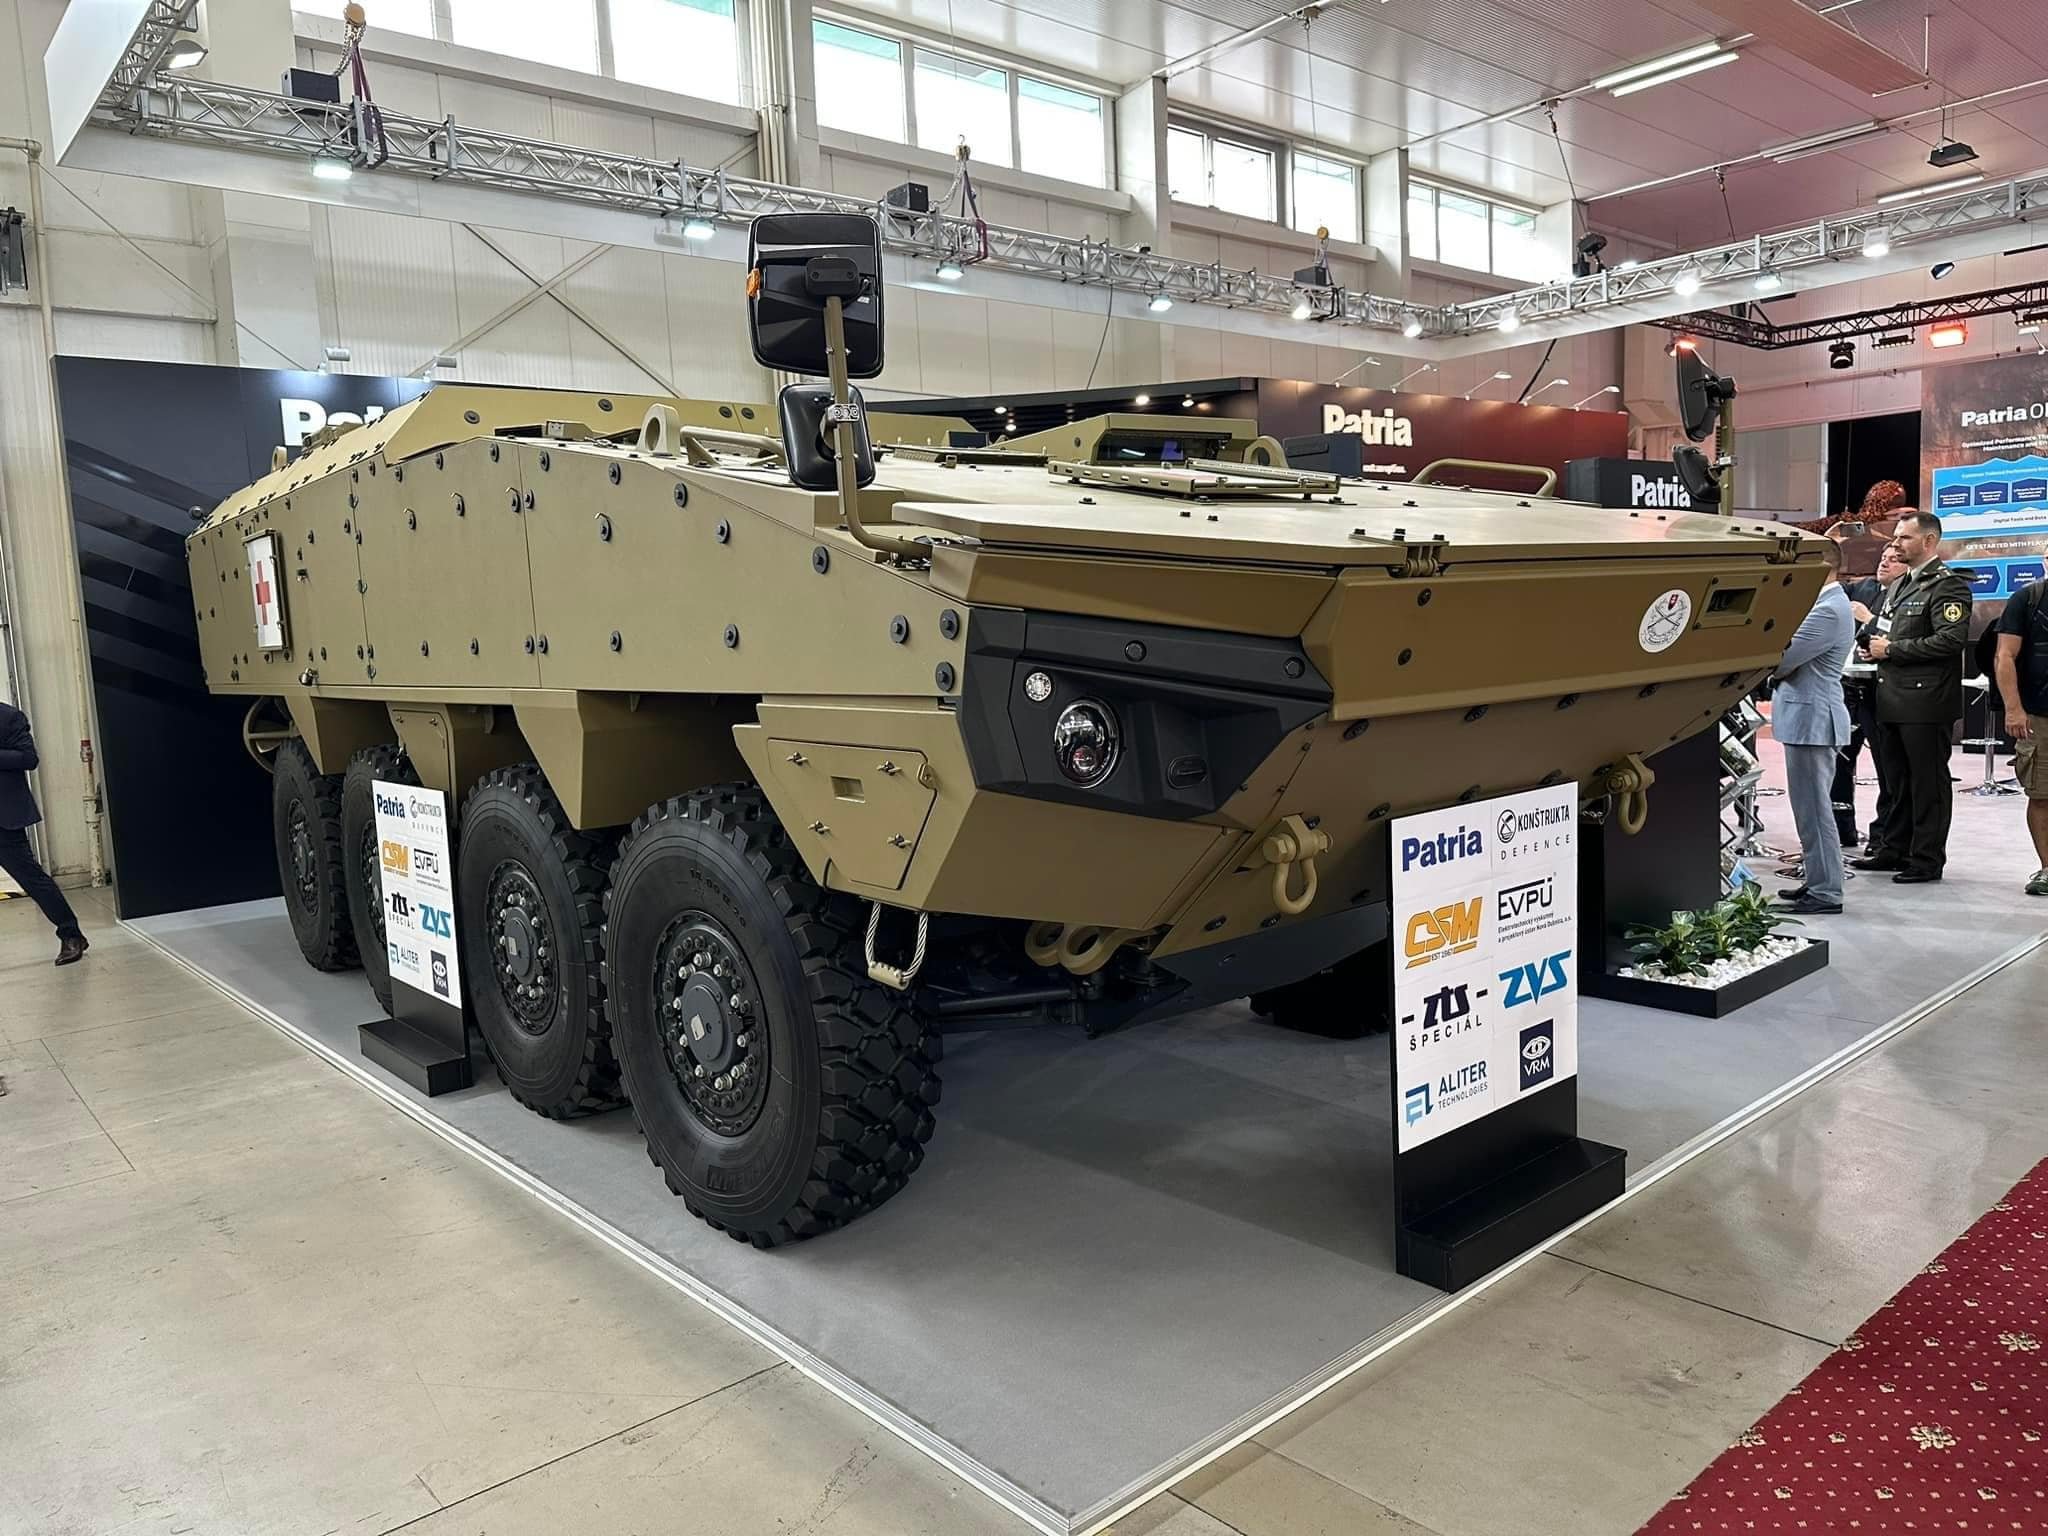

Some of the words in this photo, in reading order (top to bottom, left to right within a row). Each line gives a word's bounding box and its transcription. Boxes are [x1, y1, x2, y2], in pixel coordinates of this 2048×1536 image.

[1323, 404, 1413, 447] Patria
[1961, 406, 2028, 427] Patria
[1631, 474, 1691, 507] Patria
[376, 793, 405, 819] Patria
[1518, 804, 1570, 832] KONŠTRUKTA
[1402, 825, 1483, 872] Patria
[1500, 834, 1570, 860] DEFENCE
[1404, 897, 1483, 958] CSM
[1498, 949, 1572, 1009] ZVS
[1410, 1014, 1482, 1051] ŠPECIÁL
[1438, 1060, 1488, 1097] ALITER
[1524, 1056, 1550, 1077] VRM
[1438, 1081, 1488, 1109] TECHNOLOGIES
